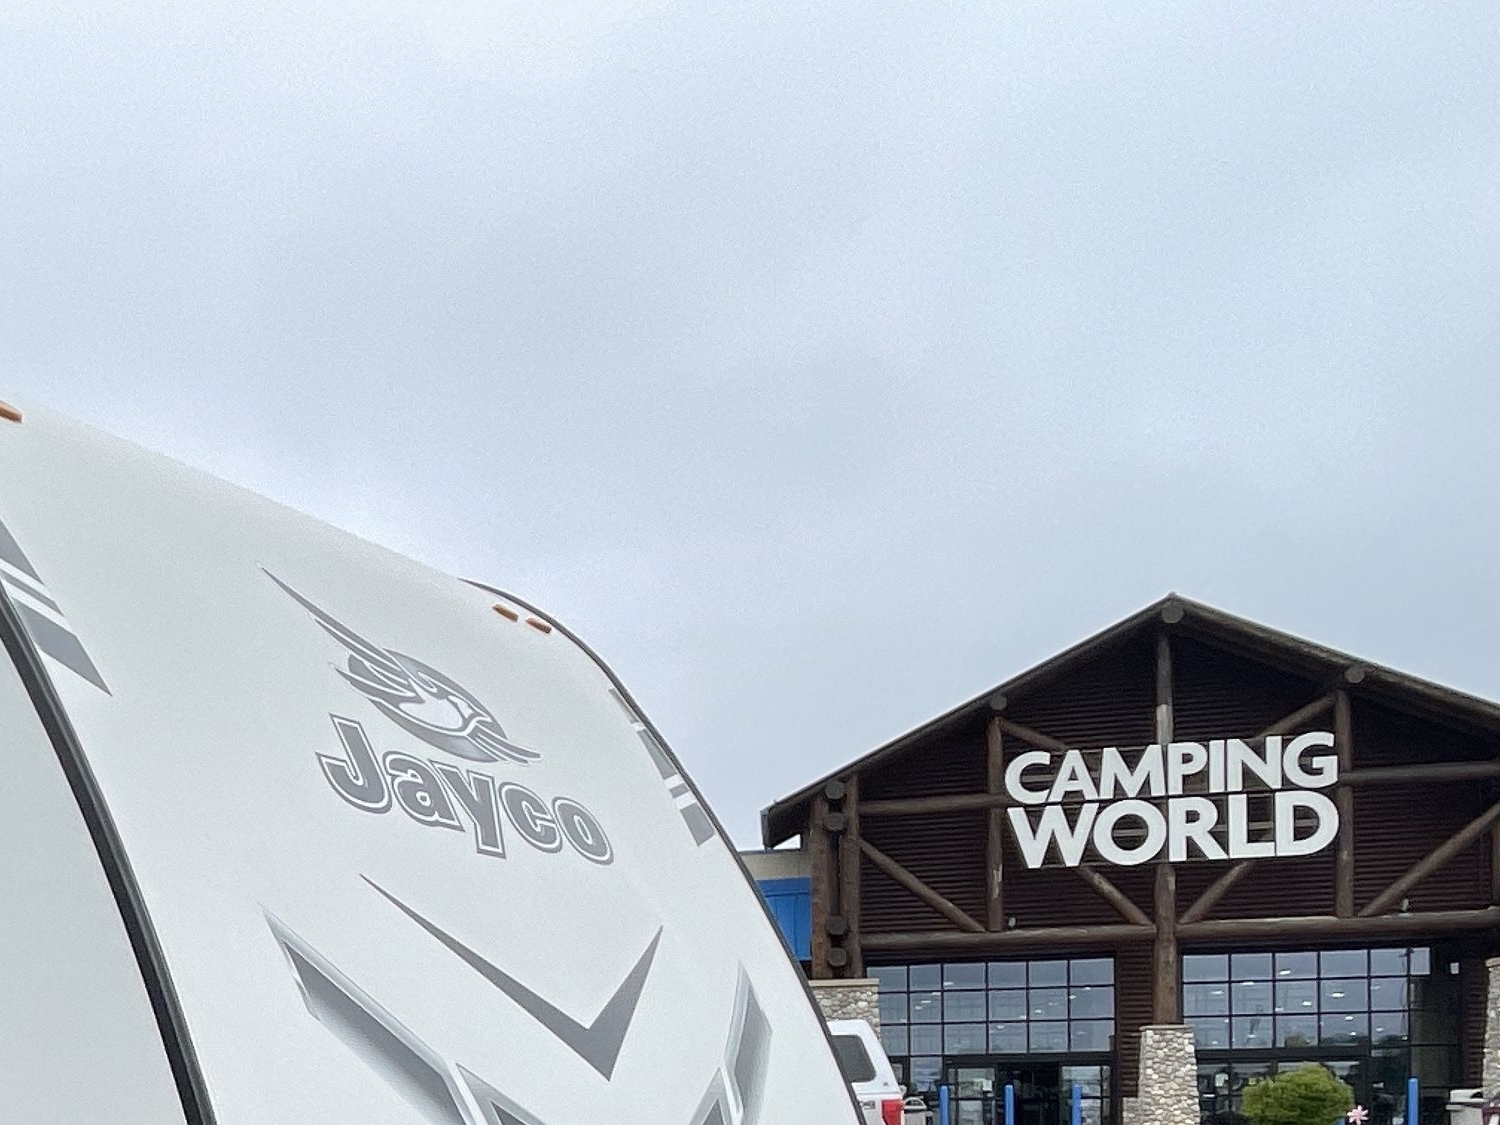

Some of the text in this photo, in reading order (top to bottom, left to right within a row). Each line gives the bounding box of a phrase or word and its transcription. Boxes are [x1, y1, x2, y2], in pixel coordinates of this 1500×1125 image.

[315, 713, 614, 865] Jayco
[1004, 731, 1339, 804] CAMPING
[1006, 791, 1340, 869] WORLD
